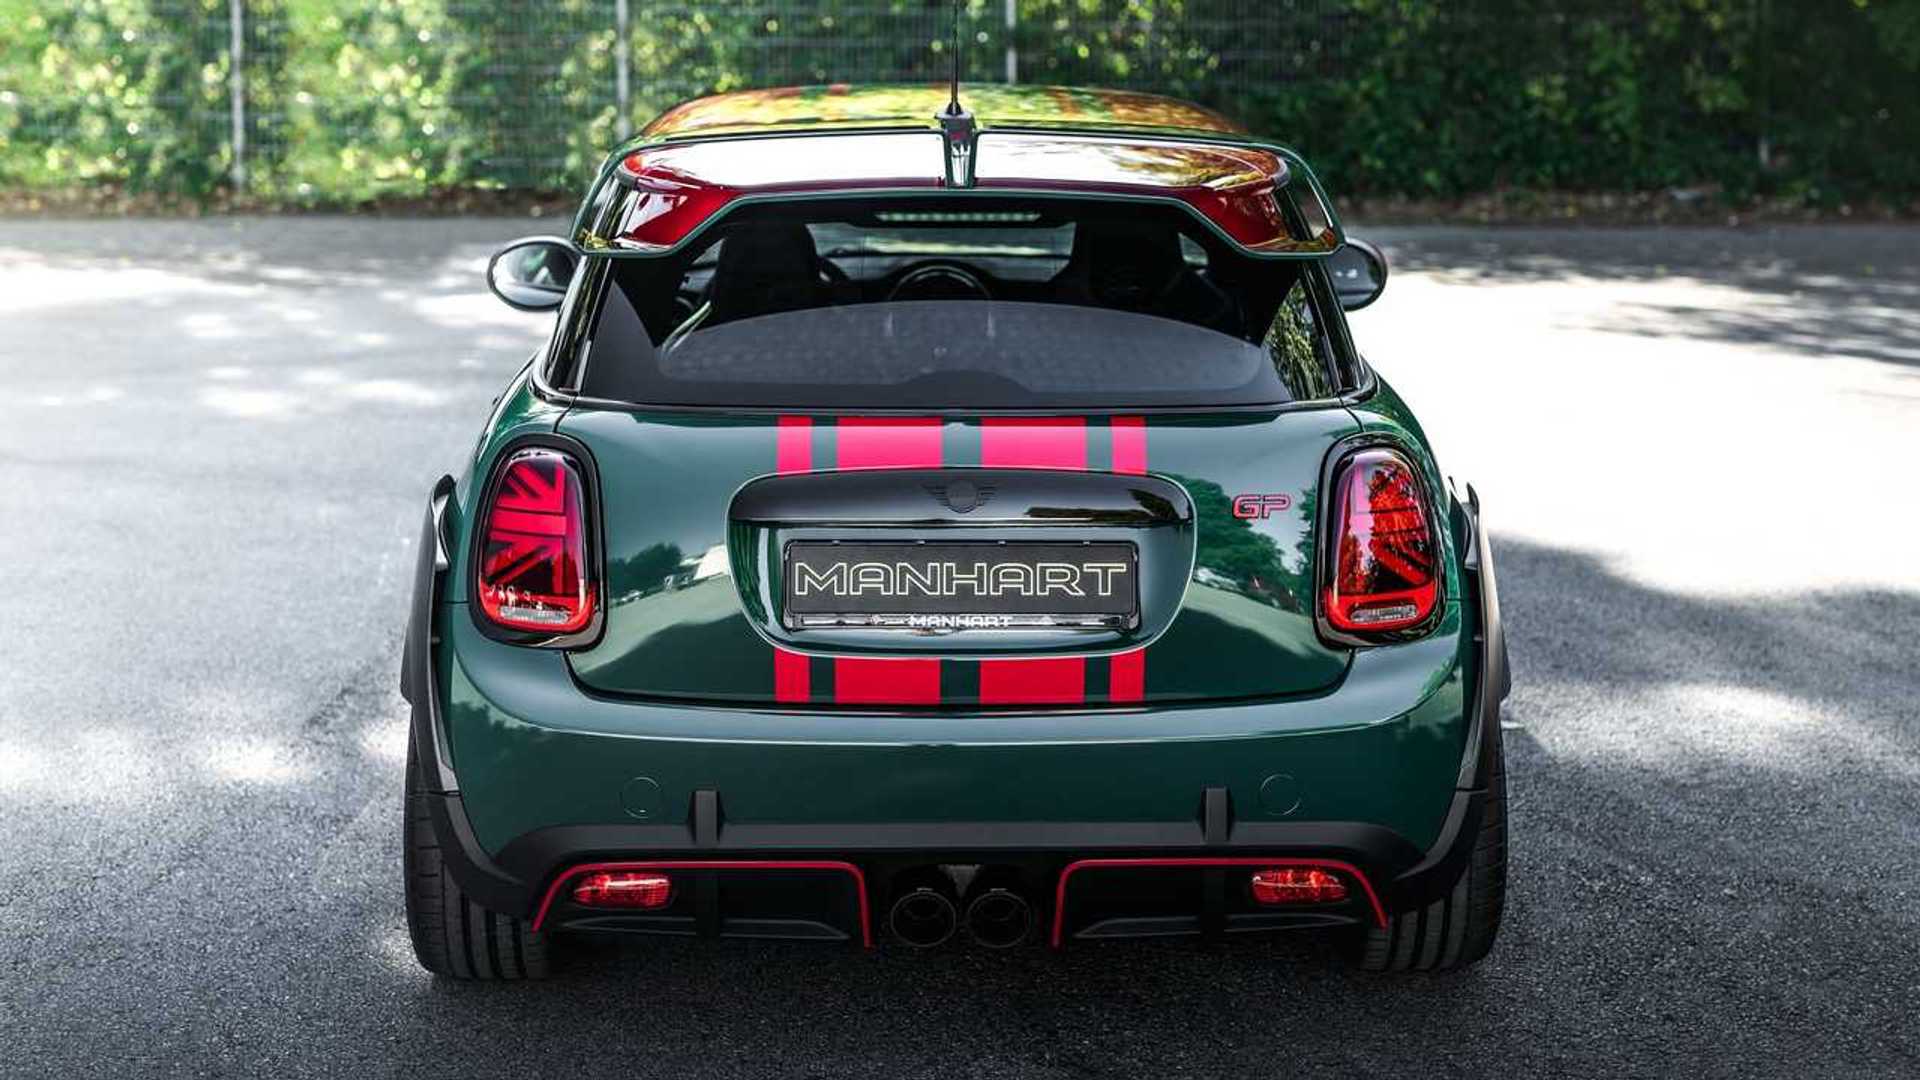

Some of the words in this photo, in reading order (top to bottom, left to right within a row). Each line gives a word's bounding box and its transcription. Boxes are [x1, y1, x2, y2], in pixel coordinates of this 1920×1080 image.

[1232, 494, 1290, 519] GP
[795, 562, 1126, 596] MANHART
[908, 615, 1013, 627] MANHART
